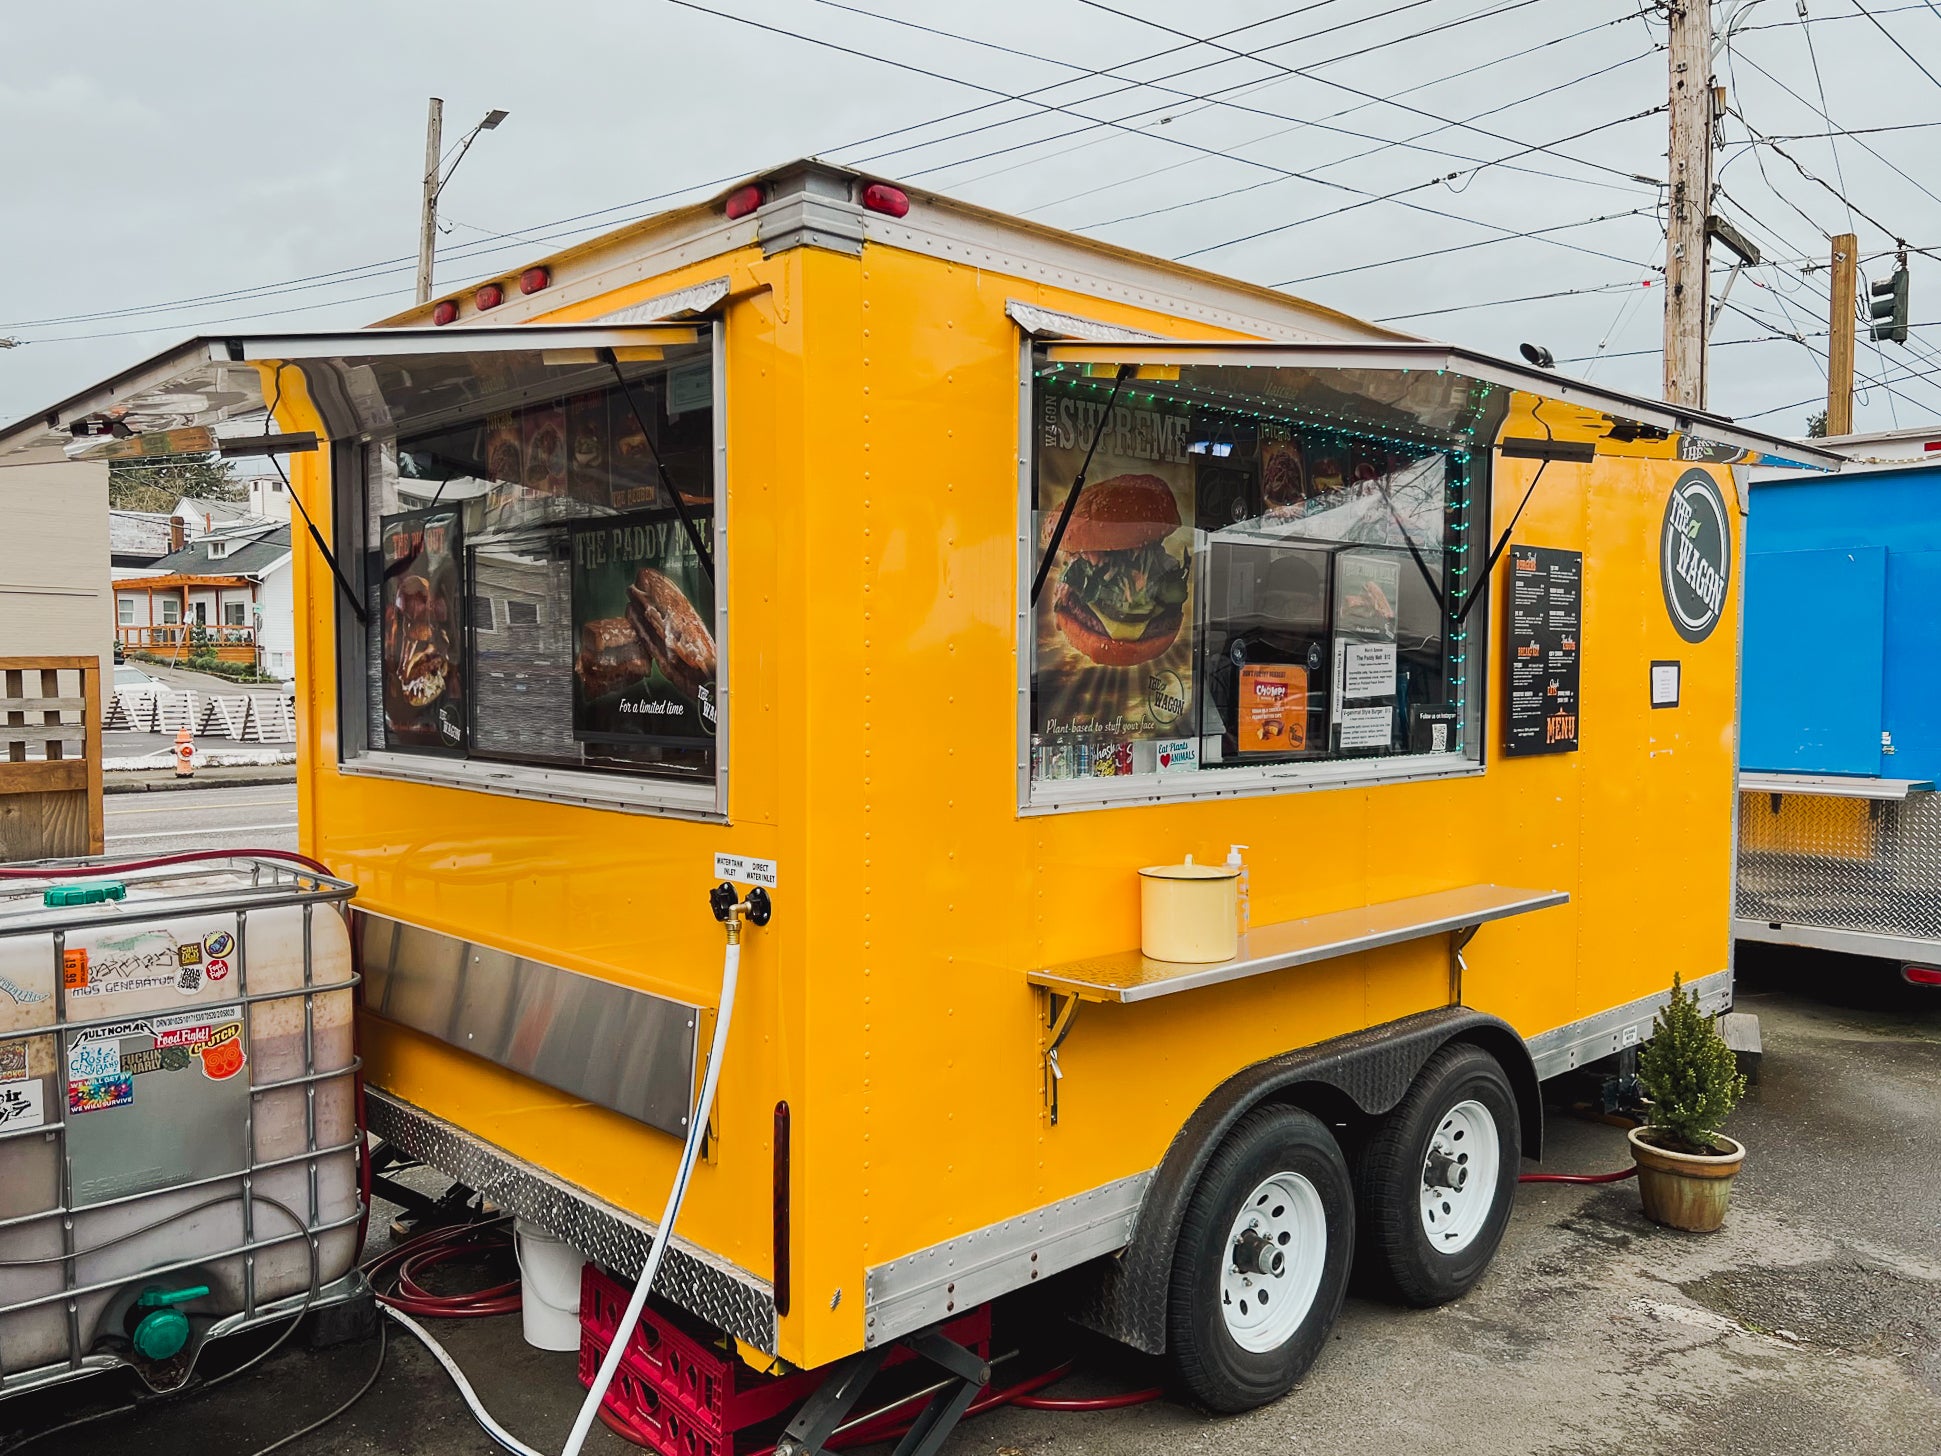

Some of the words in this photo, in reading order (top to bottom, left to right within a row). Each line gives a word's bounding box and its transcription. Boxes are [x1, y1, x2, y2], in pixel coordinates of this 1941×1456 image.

[1045, 395, 1057, 447] WAGON
[1059, 397, 1191, 465] SUPREME
[1669, 489, 1693, 536] THE
[391, 533, 410, 560] THE
[427, 527, 445, 553] OUT
[575, 530, 607, 570] THE
[611, 523, 668, 562] PADDY
[1676, 531, 1725, 616] WAGON
[1148, 675, 1161, 691] THE
[619, 698, 631, 713] For
[632, 702, 639, 713] a
[639, 698, 666, 715] limited
[666, 700, 684, 715] time
[1154, 691, 1185, 717] WAGON
[1046, 717, 1094, 734] Plant-based
[1095, 721, 1103, 732] to
[1105, 715, 1123, 735] stuff
[1123, 723, 1139, 735] your
[1139, 714, 1155, 734] face
[1546, 715, 1576, 745] MENU
[1158, 744, 1168, 754] Eat
[1169, 742, 1188, 751] Plants
[1171, 750, 1195, 763] ANIMALS
[717, 857, 731, 866] WATER
[731, 859, 744, 868] TANK
[752, 862, 769, 872] DIRECT
[724, 867, 736, 876] INLET
[746, 871, 762, 881] WATER
[762, 873, 775, 883] INLET
[65, 959, 77, 984] 19.99
[105, 976, 175, 993] GENERATOR
[157, 1029, 182, 1046] Food
[181, 1027, 209, 1042] Fight!
[121, 1049, 162, 1066] FUCKIN
[71, 1060, 95, 1075] City
[70, 1081, 83, 1089] WE
[84, 1078, 103, 1086] WILL
[104, 1075, 119, 1083] GET
[120, 1072, 131, 1080] BY
[71, 1104, 83, 1113] WE
[83, 1101, 101, 1111] WILL
[101, 1096, 132, 1107] SURVIVE
